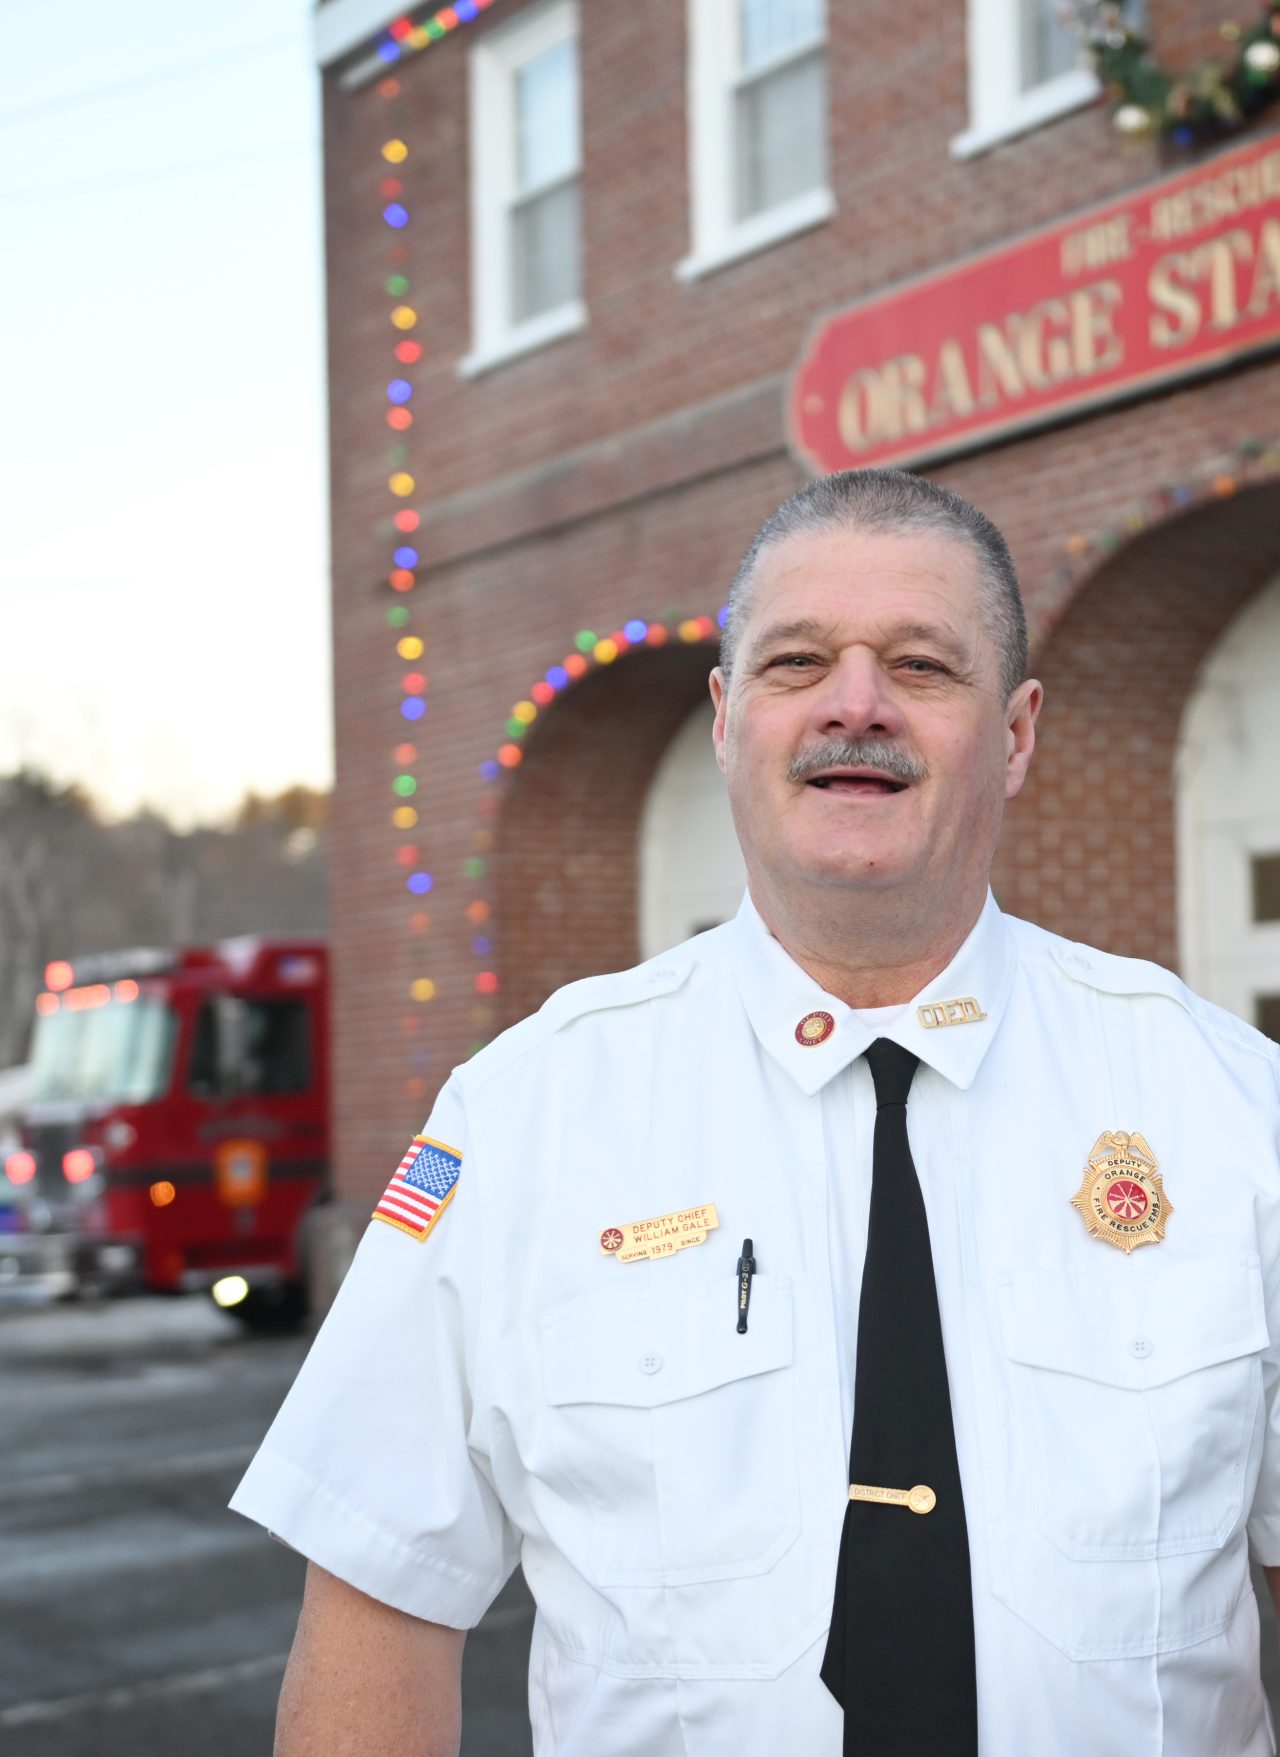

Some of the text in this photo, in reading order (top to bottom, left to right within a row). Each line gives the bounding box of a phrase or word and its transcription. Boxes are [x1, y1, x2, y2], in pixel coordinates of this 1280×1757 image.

[837, 279, 1125, 453] ORANGE
[1104, 1168, 1146, 1182] ORANGE
[1107, 1158, 1141, 1168] DEPUTY
[632, 1208, 708, 1234] DEPUTY CHIEF
[1093, 1197, 1159, 1232] FIRE RESCUE EMS
[634, 1218, 711, 1243] WILLIAM GALE
[621, 1236, 701, 1261] SERVING 1979 SINCE
[740, 1290, 748, 1309] PILOT
[854, 1487, 907, 1500] DISTRICT CHIEF
